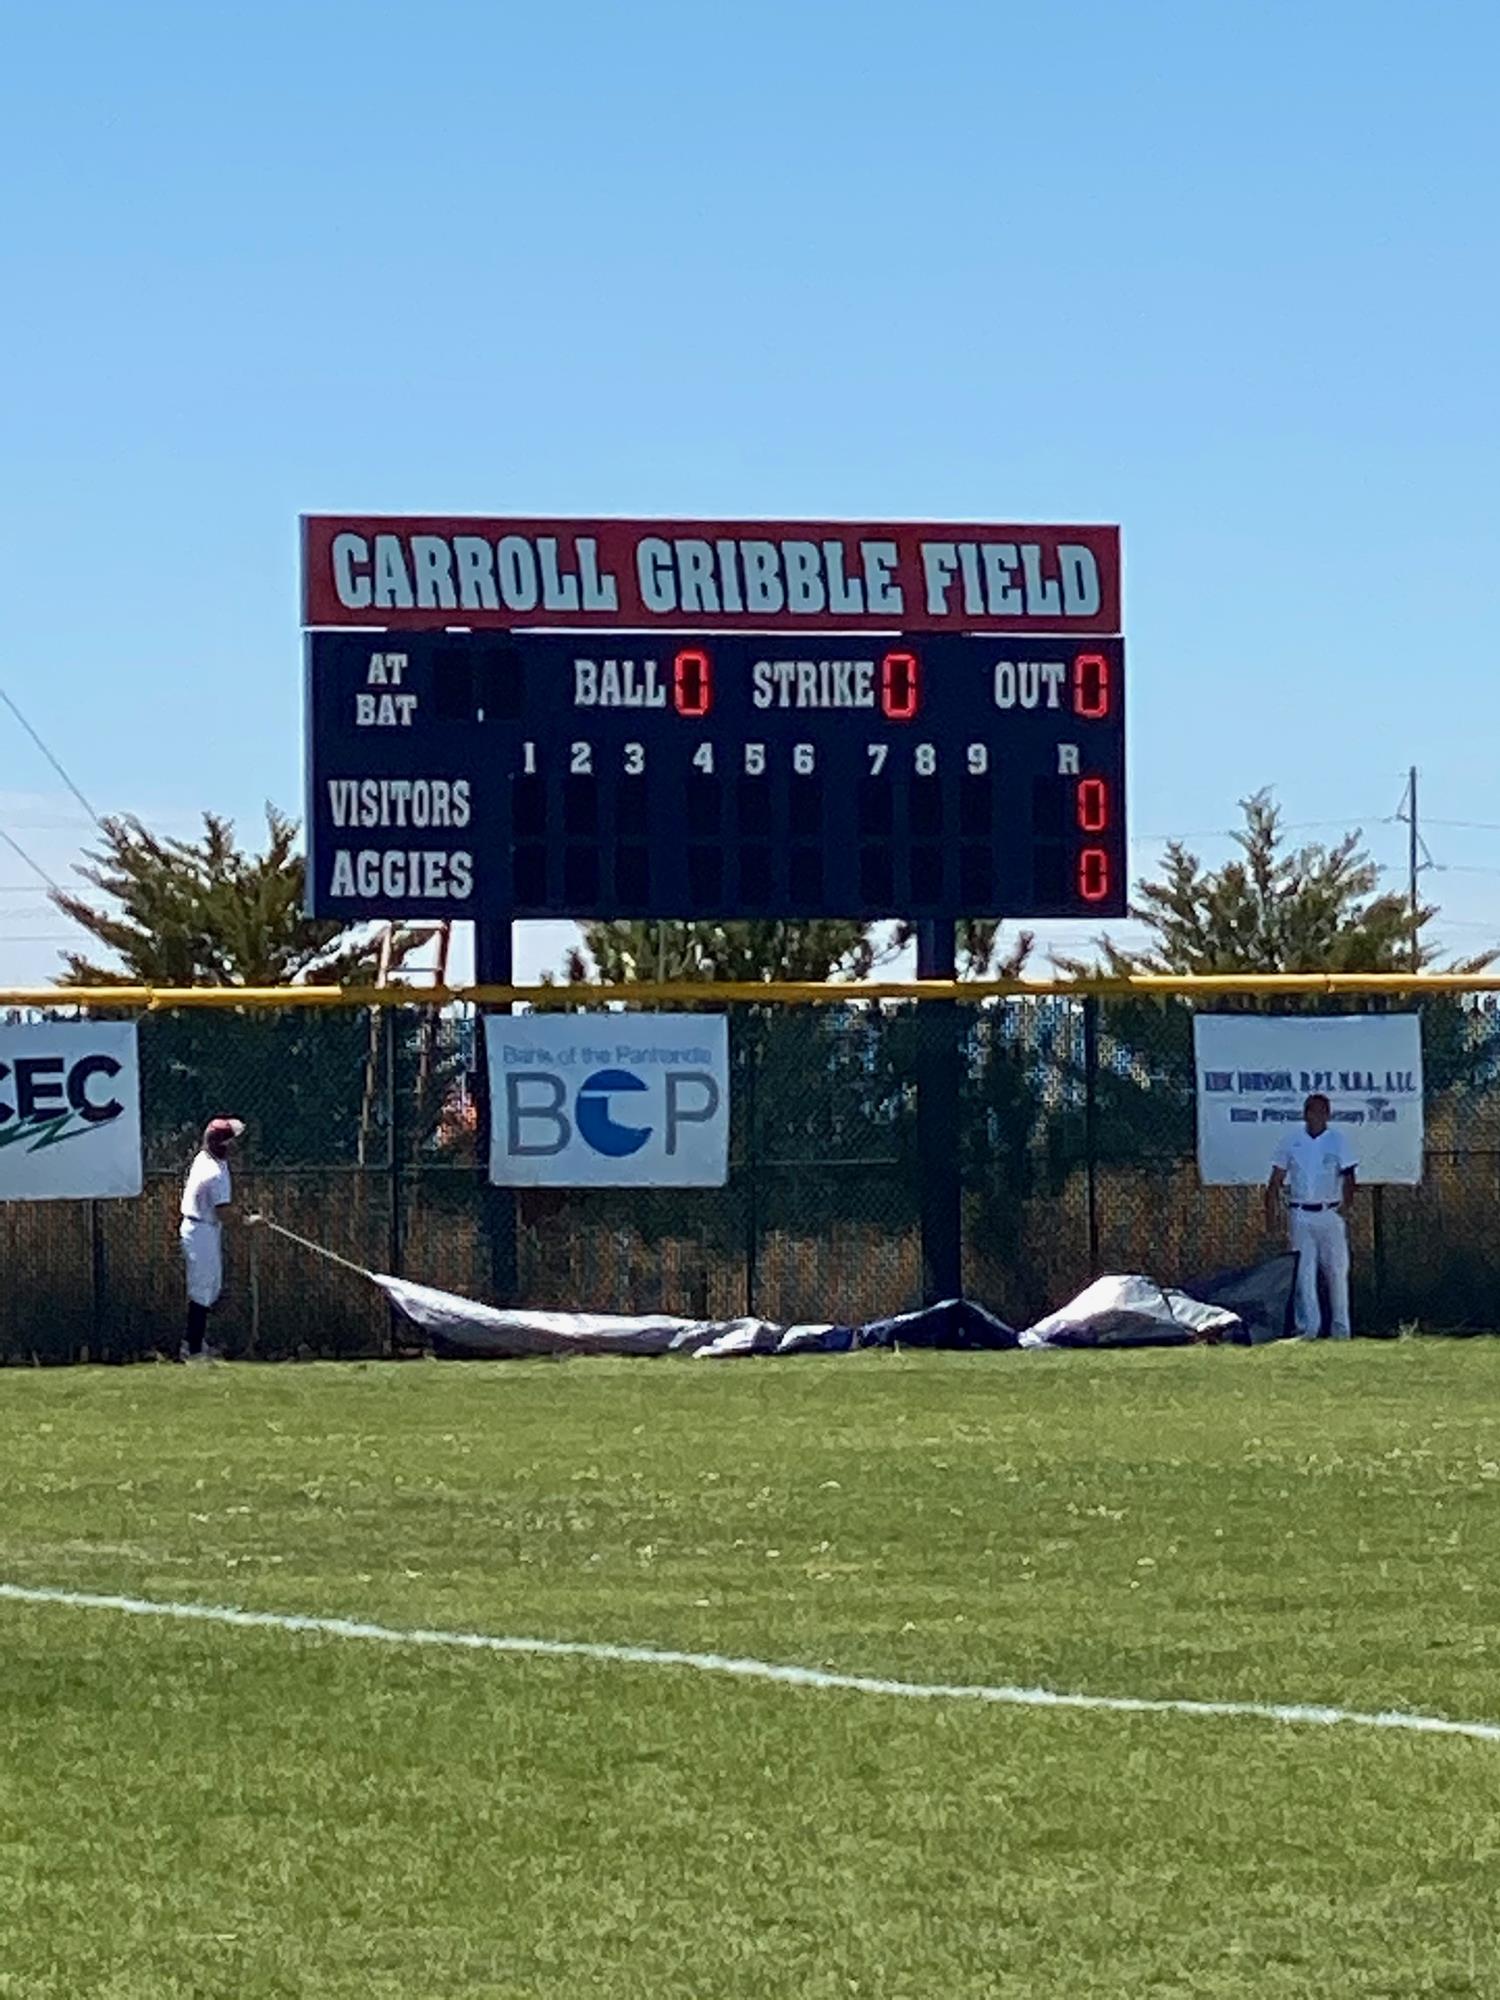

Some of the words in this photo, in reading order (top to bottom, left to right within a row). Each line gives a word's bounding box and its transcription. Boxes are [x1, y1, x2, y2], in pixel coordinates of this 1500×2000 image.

[332, 533, 618, 611] CARROLL
[636, 537, 904, 614] GRIBBLE
[920, 543, 1101, 616] FIELD
[367, 653, 408, 685] AT
[574, 660, 666, 707] BALL
[674, 650, 709, 716] 0
[753, 661, 875, 709] STRIKE
[881, 653, 917, 719] 0
[994, 661, 1066, 709] OUT
[1073, 654, 1109, 719] 0
[356, 694, 417, 726] BAT
[523, 742, 536, 774] 1
[570, 742, 592, 774] 2
[624, 743, 645, 775] 3
[693, 742, 713, 774] 4
[745, 743, 765, 775] 5
[793, 743, 815, 775] 6
[868, 743, 888, 775] 7
[915, 743, 936, 775] 8
[967, 743, 988, 775] 9
[1058, 743, 1080, 775] R
[328, 779, 471, 828] VISITORS
[1077, 779, 1106, 831] 0
[330, 849, 474, 899] AGGIES
[1080, 849, 1108, 900] 0
[0, 1055, 124, 1124] EC
